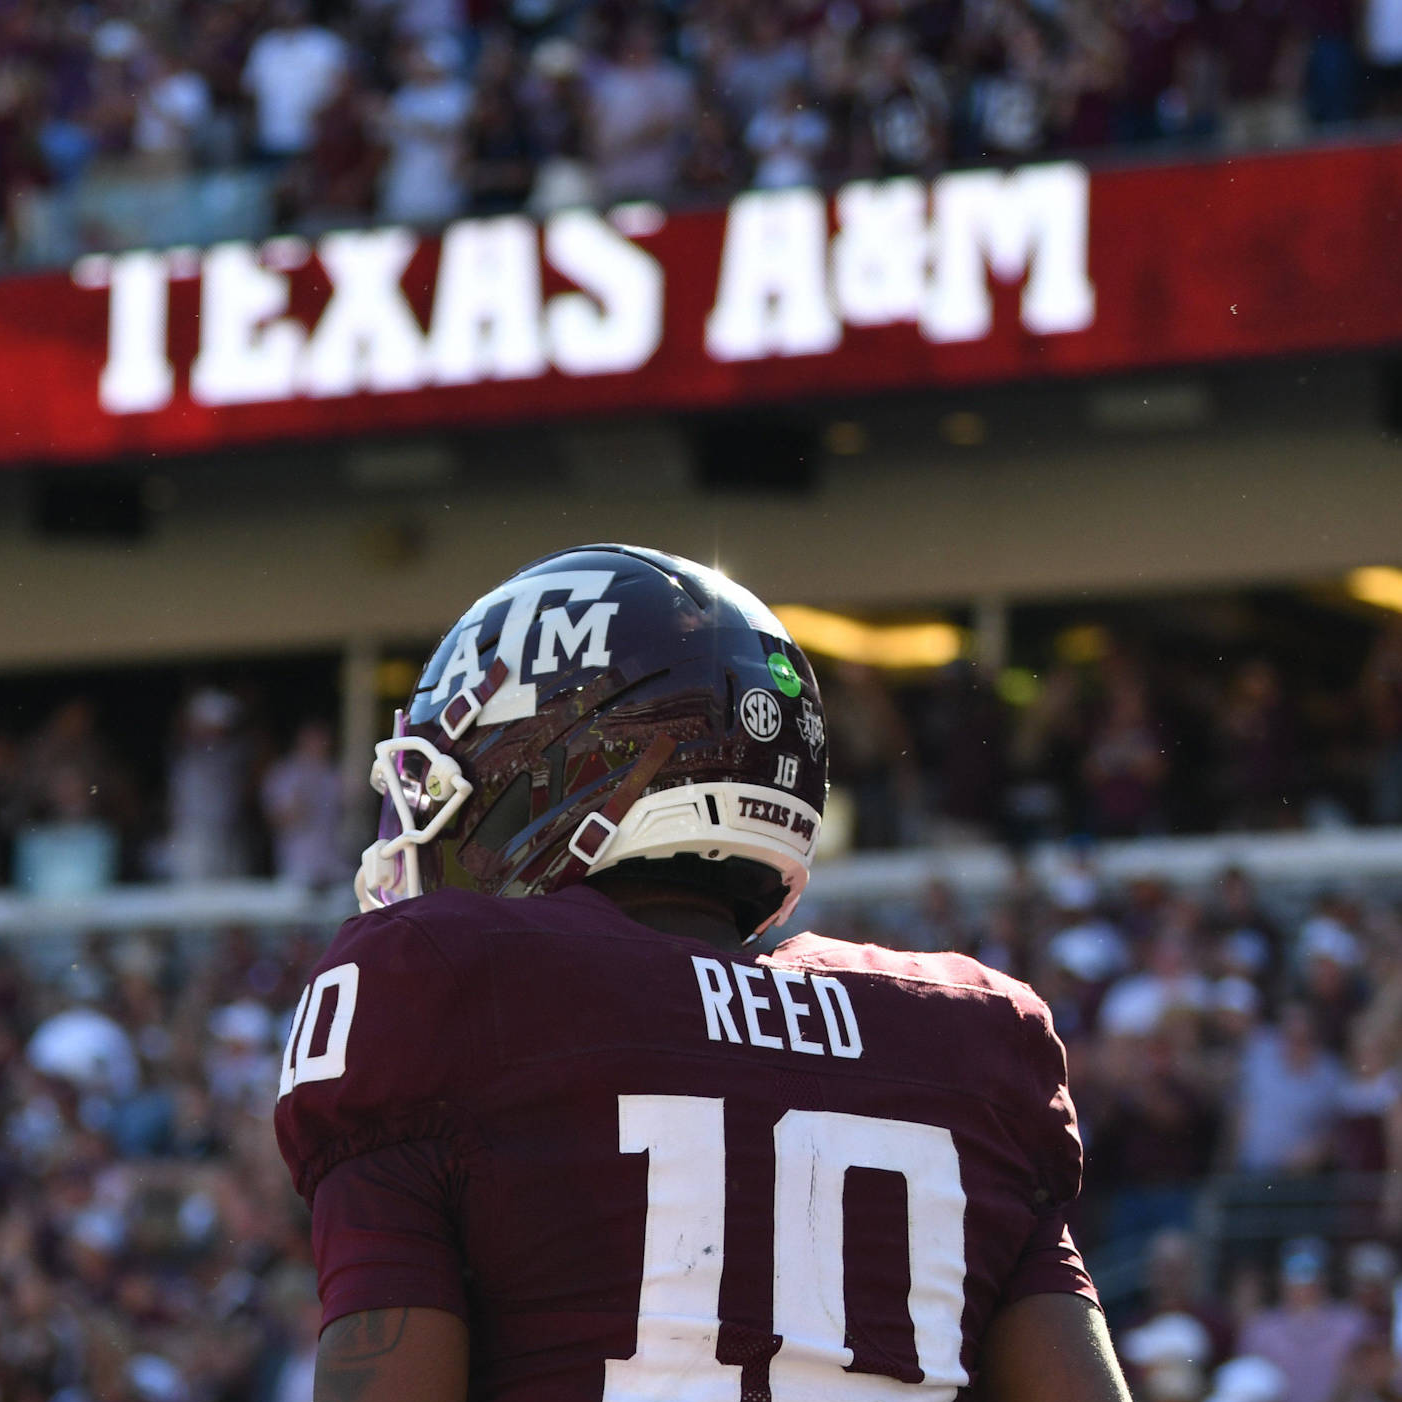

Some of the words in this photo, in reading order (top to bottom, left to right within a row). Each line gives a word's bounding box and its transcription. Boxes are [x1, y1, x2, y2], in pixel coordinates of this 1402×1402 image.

[74, 202, 665, 414] TEXAS
[705, 161, 1094, 361] A&M
[745, 692, 779, 737] SEC
[773, 754, 798, 790] 10
[738, 796, 791, 828] TEXAS
[690, 955, 864, 1059] REED
